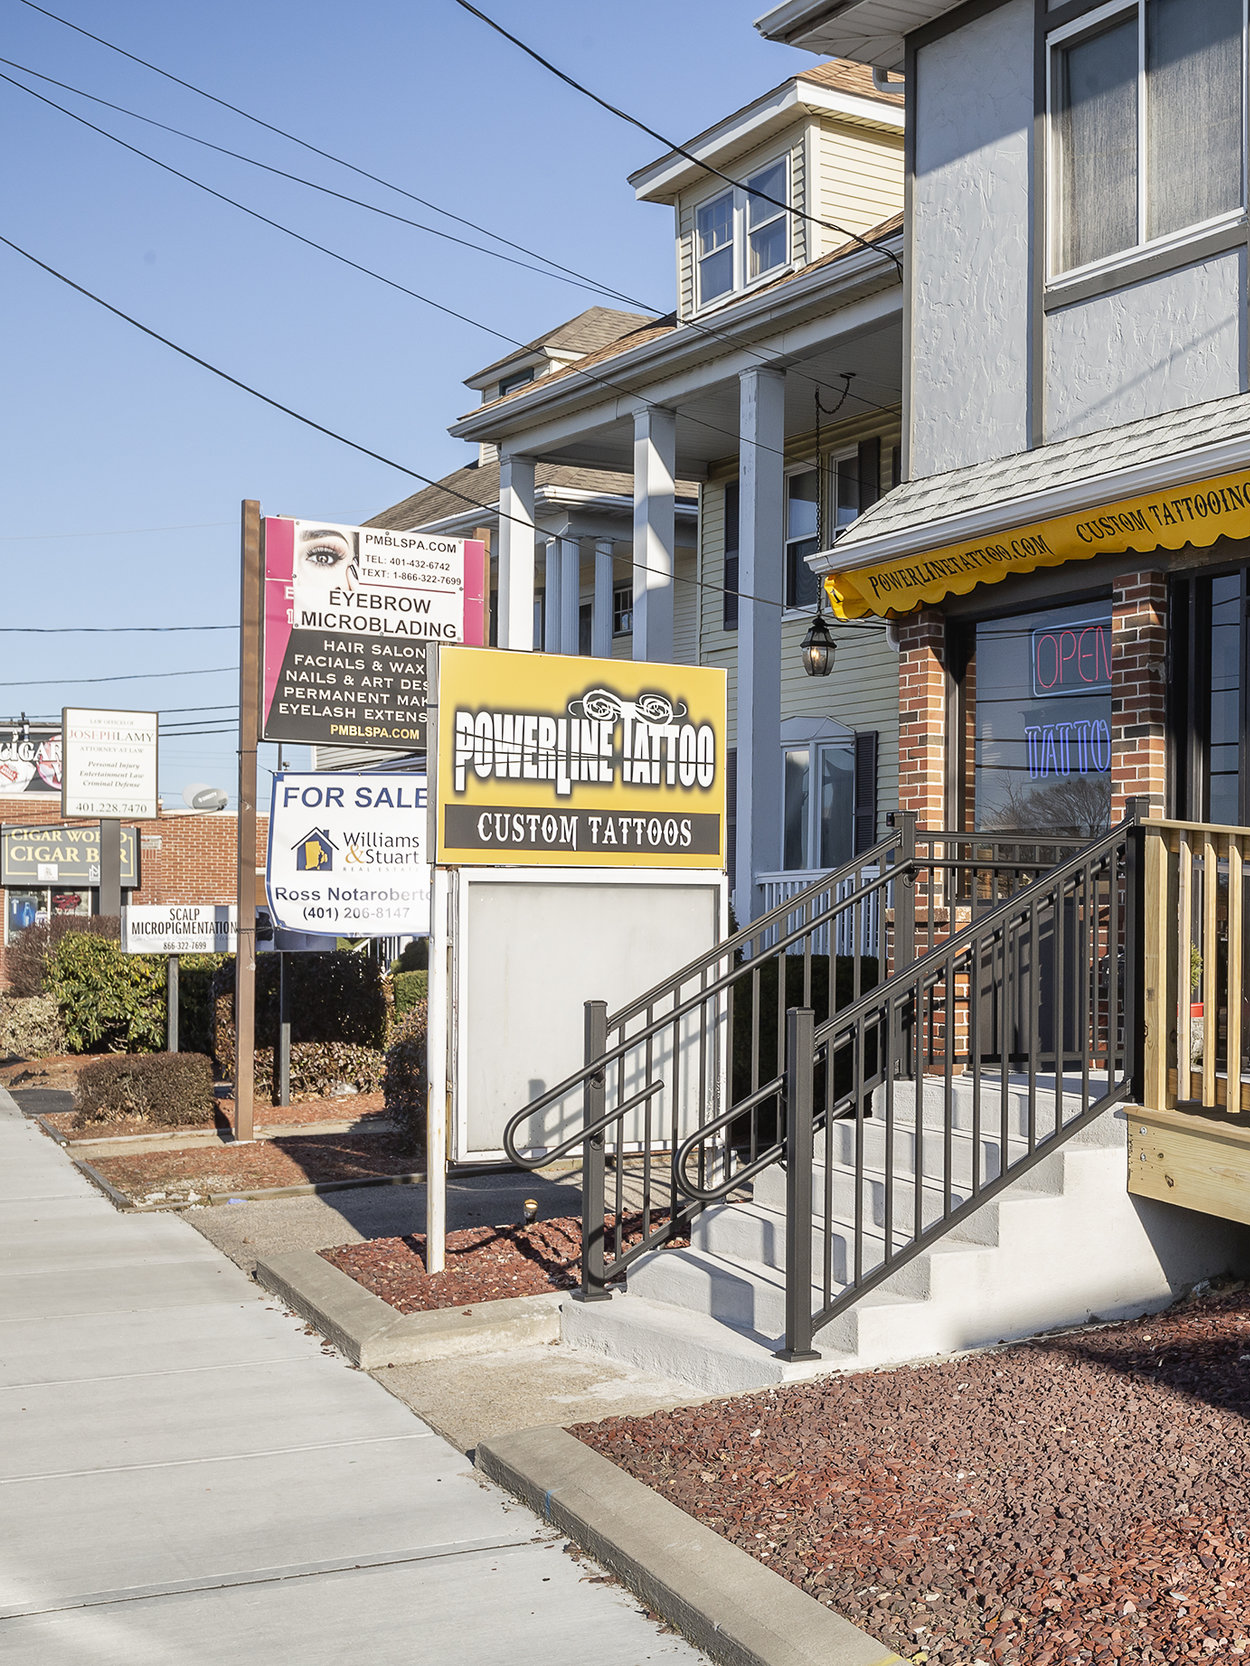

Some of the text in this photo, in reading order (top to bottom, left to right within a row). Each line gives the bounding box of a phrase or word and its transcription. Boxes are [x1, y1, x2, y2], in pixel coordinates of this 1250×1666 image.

[1075, 509, 1154, 543] CUSTOM
[365, 534, 457, 553] PMBLSPA.COM
[365, 554, 450, 571] TEL: 401-432-6742
[868, 534, 1056, 599] POWERLINETATTOO.COM
[362, 568, 462, 586] TEXT: 1-866-322-7699
[329, 590, 431, 614] EYEBROW
[301, 611, 457, 638] MICROBLADING
[324, 640, 426, 659] HAIR SALON
[1037, 626, 1112, 688] OPEN
[294, 654, 425, 675] FACIALS & WAX
[286, 671, 337, 684] NAILS
[343, 675, 354, 686] &
[361, 676, 394, 689] ART
[284, 687, 390, 705] PERMANENT
[279, 703, 428, 723] EYELASH EXTENS
[330, 724, 420, 740] PMBLSPA.COM
[455, 700, 715, 795] POWERLINE TATTOO
[79, 770, 127, 778] Entertainment
[115, 781, 140, 789] Defense
[283, 787, 427, 808] FOR SALE
[76, 802, 147, 814] 401.228.7470
[11, 828, 128, 843] CIGAR WOD
[343, 831, 420, 848] Williams
[477, 812, 692, 851] CUSTOM TATTOOS
[10, 846, 128, 863] CIGAR BR
[275, 887, 321, 902] Ross
[169, 908, 200, 921] SCALP
[303, 907, 410, 921] (401) 206-8147
[131, 921, 237, 935] MICROPIGMENTATION
[163, 942, 207, 950] 866-322-7699
